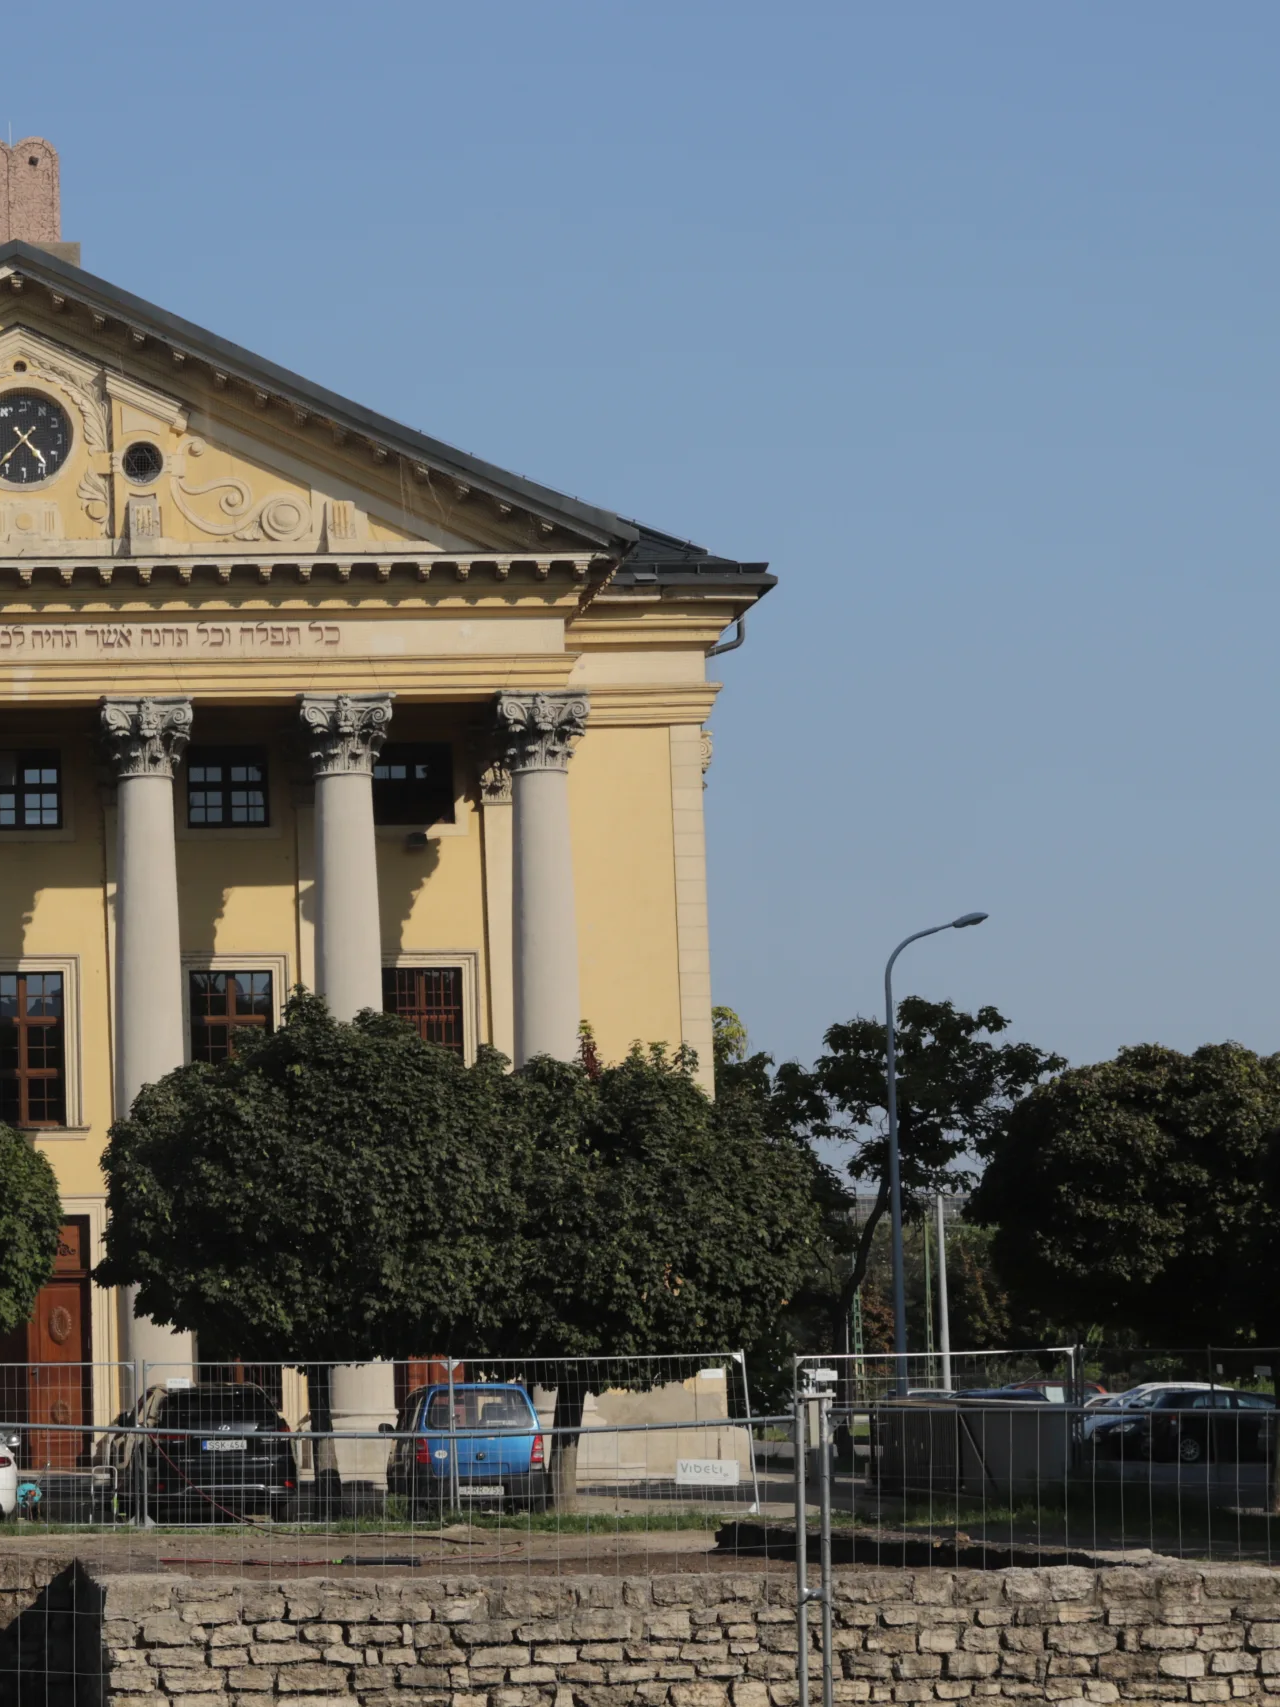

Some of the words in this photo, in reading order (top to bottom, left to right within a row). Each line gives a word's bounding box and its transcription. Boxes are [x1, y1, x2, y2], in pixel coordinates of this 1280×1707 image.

[0, 407, 13, 417] יא
[19, 402, 32, 412] יב
[38, 406, 46, 417] א
[50, 417, 58, 428] ב
[57, 433, 62, 445] ג
[50, 450, 58, 462] ד
[4, 463, 10, 474] ז
[21, 467, 27, 479] ו
[31, 629, 78, 649] תהיה
[85, 625, 133, 649] אשר
[140, 628, 189, 648] תחנה
[196, 621, 231, 647] וכל
[240, 621, 300, 646] תפלה
[308, 621, 340, 646] כל
[208, 1441, 245, 1450] SSK-454
